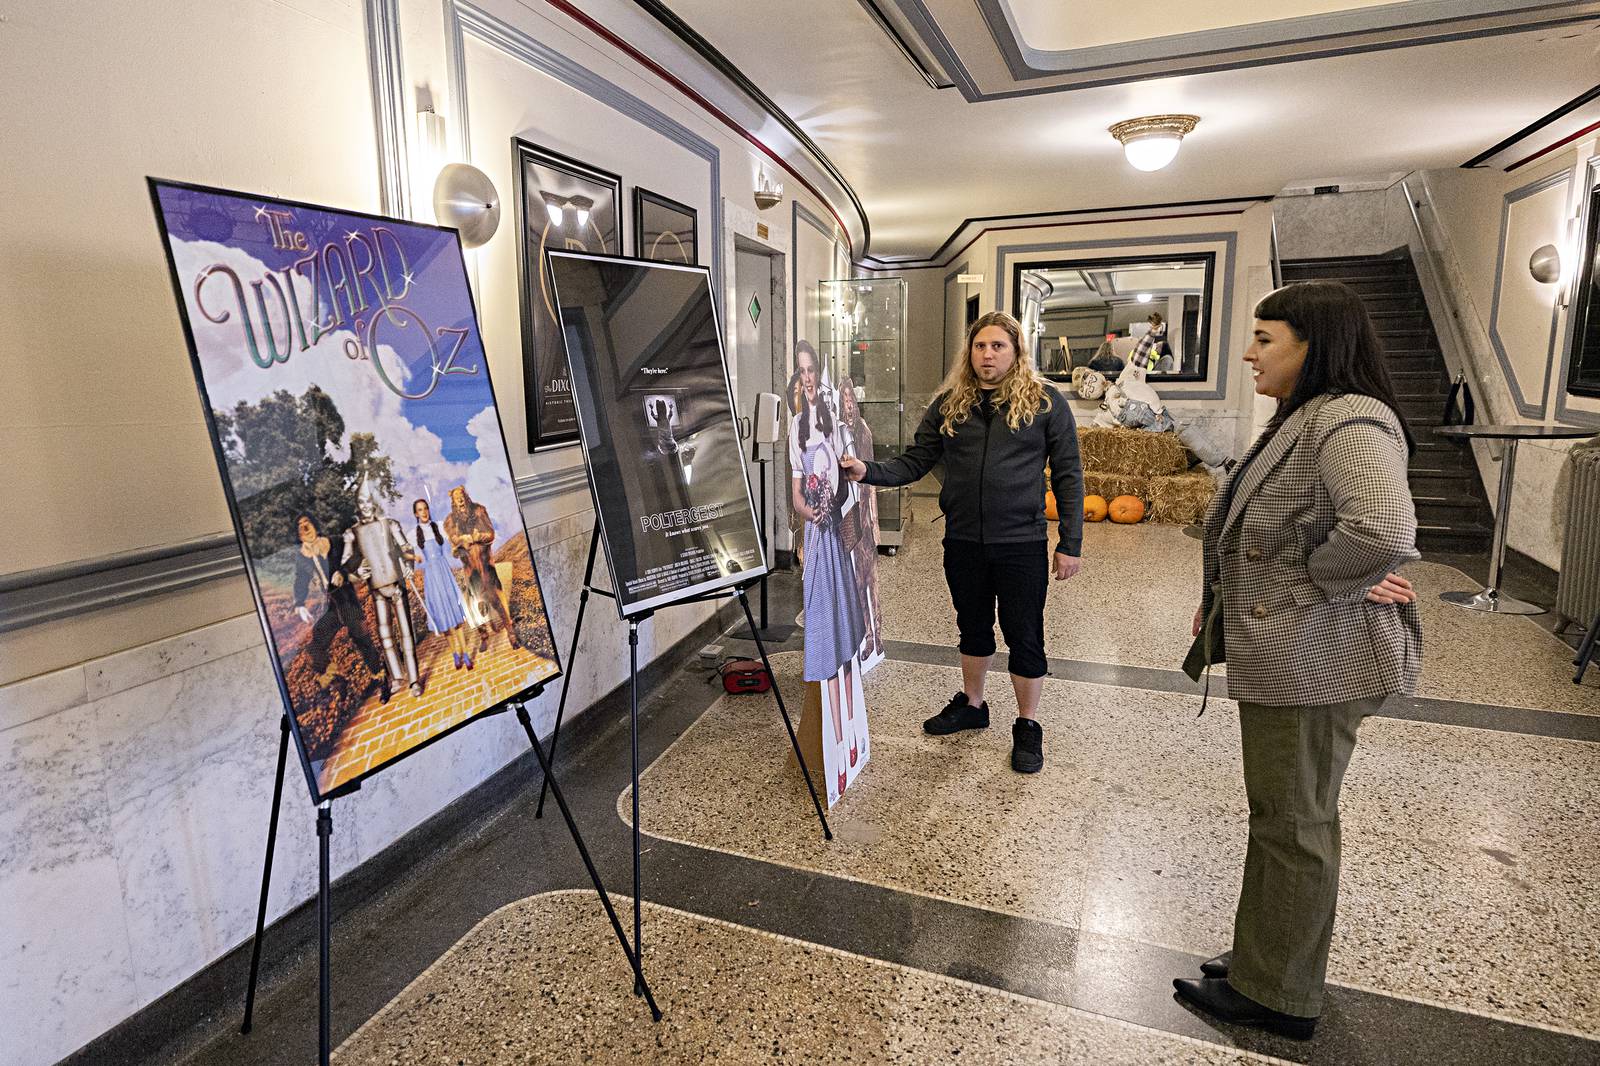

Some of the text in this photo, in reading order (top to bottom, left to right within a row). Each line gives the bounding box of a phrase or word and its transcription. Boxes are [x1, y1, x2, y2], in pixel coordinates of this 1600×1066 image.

[256, 208, 310, 252] The
[194, 226, 413, 370] WIZARD
[343, 305, 479, 400] of Oz
[640, 503, 724, 532] POLTERGEIST
